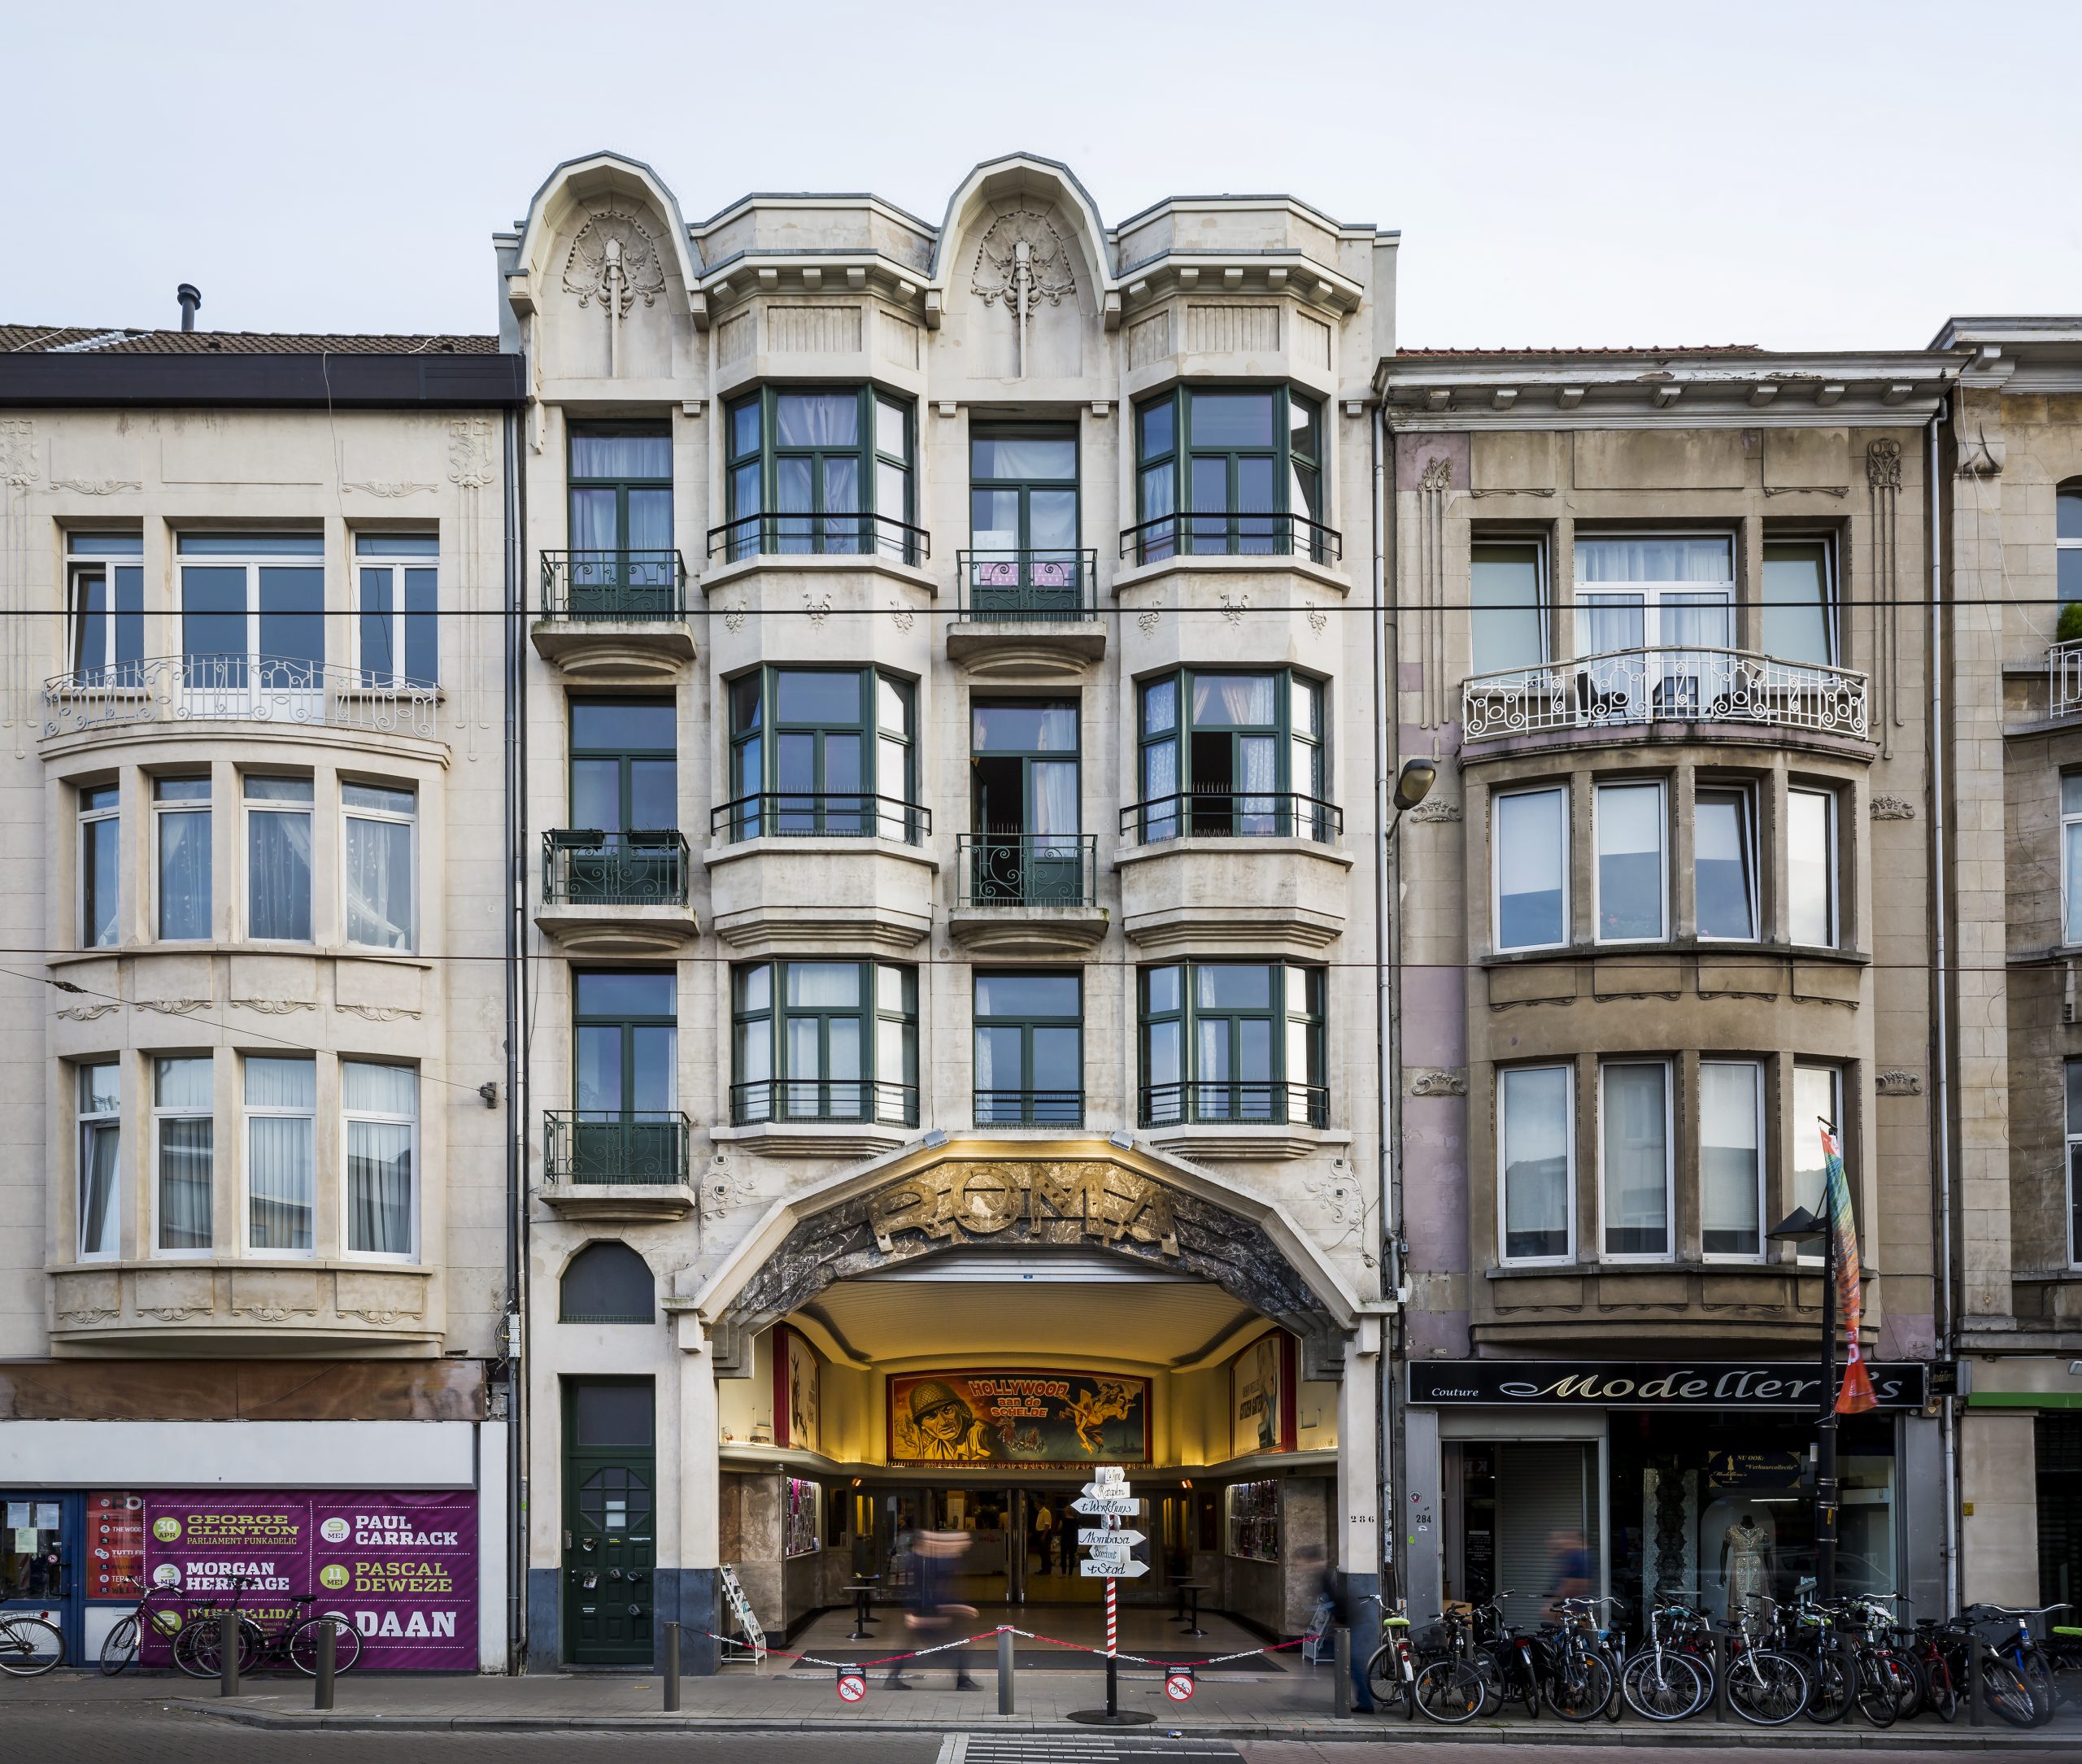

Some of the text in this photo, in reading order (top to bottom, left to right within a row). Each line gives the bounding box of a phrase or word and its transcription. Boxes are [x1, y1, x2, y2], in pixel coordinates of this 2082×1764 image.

[865, 1162, 1181, 1257] ROMA
[968, 1379, 1069, 1396] HOLLYWOOD
[1500, 1370, 1902, 1399] Modeller's
[1431, 1387, 1479, 1397] Couture
[997, 1396, 1041, 1407] aan de
[991, 1407, 1048, 1417] SCHELDE
[187, 1515, 288, 1524] GEORGE
[355, 1515, 412, 1530] PAUL
[1350, 1515, 1374, 1523] 286
[1416, 1514, 1431, 1523] 284
[157, 1520, 176, 1532] 30
[187, 1526, 299, 1535] CLINTON
[327, 1521, 344, 1532] 9
[355, 1531, 458, 1545] CARRACK
[1079, 1531, 1130, 1544] Mombasa
[161, 1568, 175, 1579] 3
[186, 1562, 275, 1575] MORGAN
[329, 1568, 341, 1579] 11
[355, 1562, 448, 1576] PASCAL
[355, 1579, 452, 1592] DEWEZE
[355, 1611, 456, 1637] DAAN
